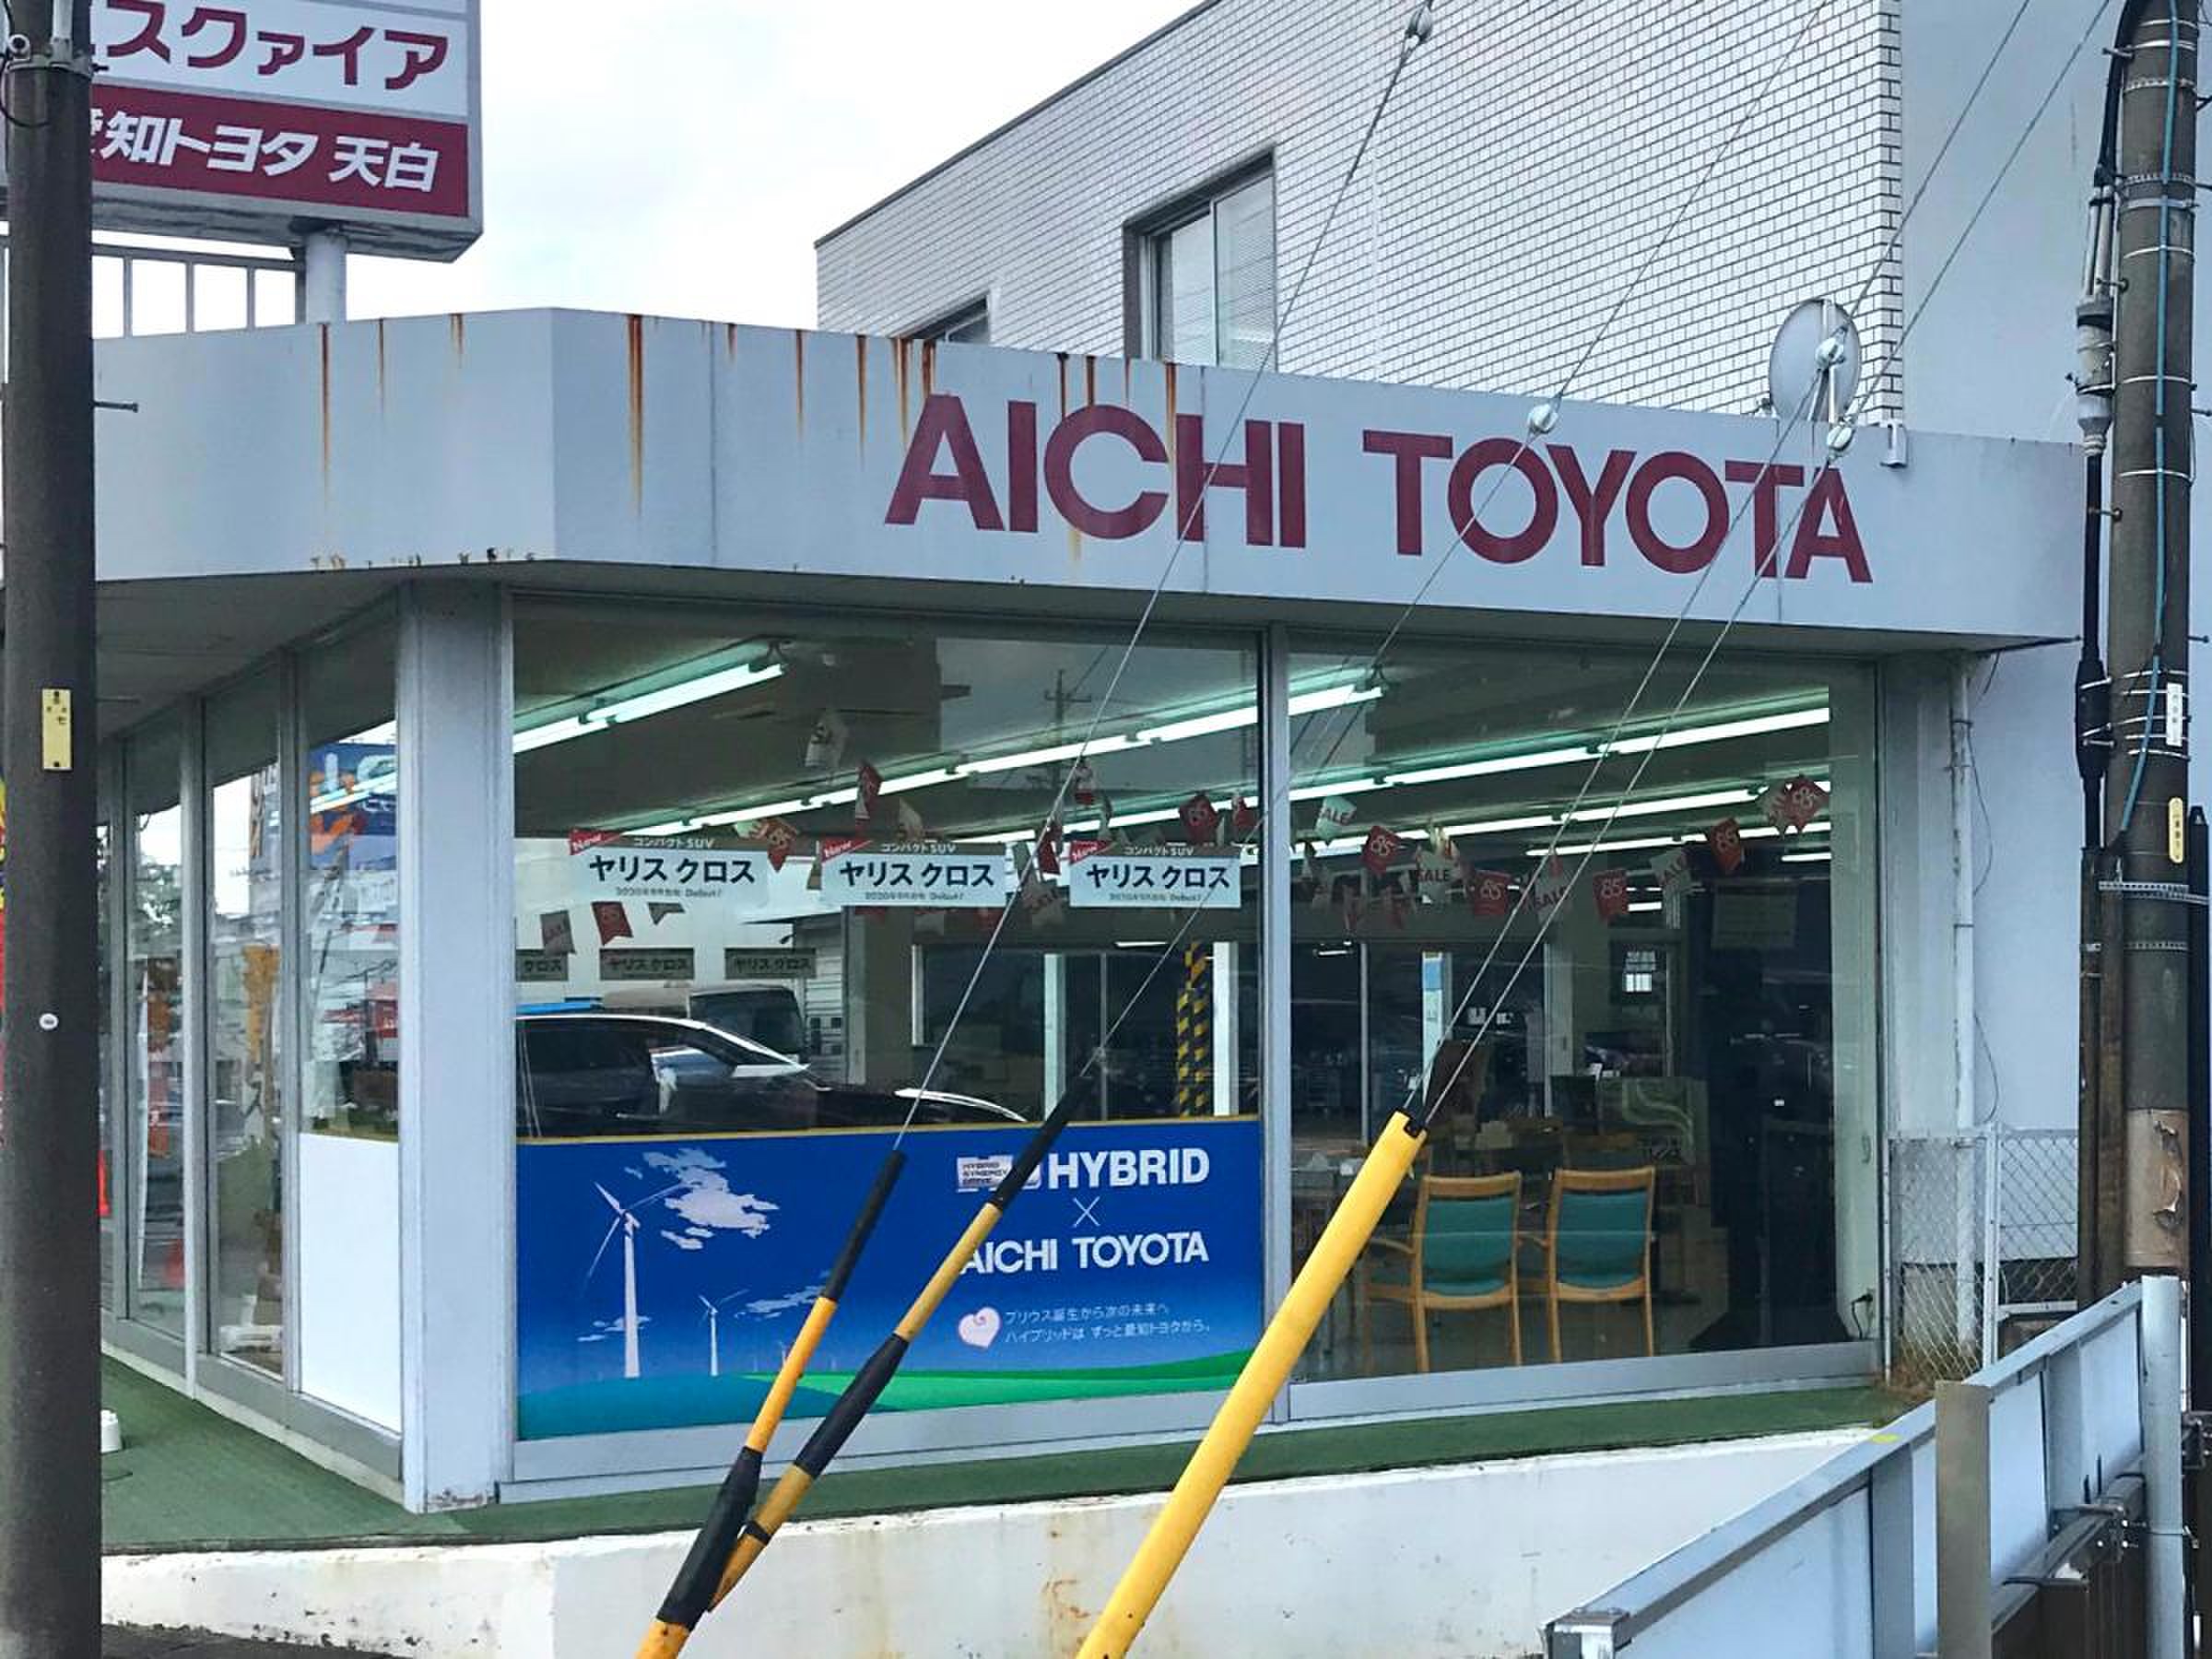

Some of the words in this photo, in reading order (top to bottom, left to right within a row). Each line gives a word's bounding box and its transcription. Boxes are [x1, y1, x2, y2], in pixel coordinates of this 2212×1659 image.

[90, 0, 448, 89] スクァイア
[328, 135, 440, 192] 天白
[884, 394, 1307, 549] AICHI
[1362, 429, 1874, 584] TOYOTA
[589, 855, 668, 882] ヤリス
[676, 858, 756, 884] クロス
[840, 862, 913, 887] ヤリス
[922, 863, 994, 888] クロス
[1087, 864, 1155, 888] ヤリス
[1162, 865, 1230, 889] クロス
[1047, 1148, 1210, 1190] HYBRID
[959, 1239, 1058, 1275] AICHI
[1072, 1231, 1210, 1269] TOYOTA
